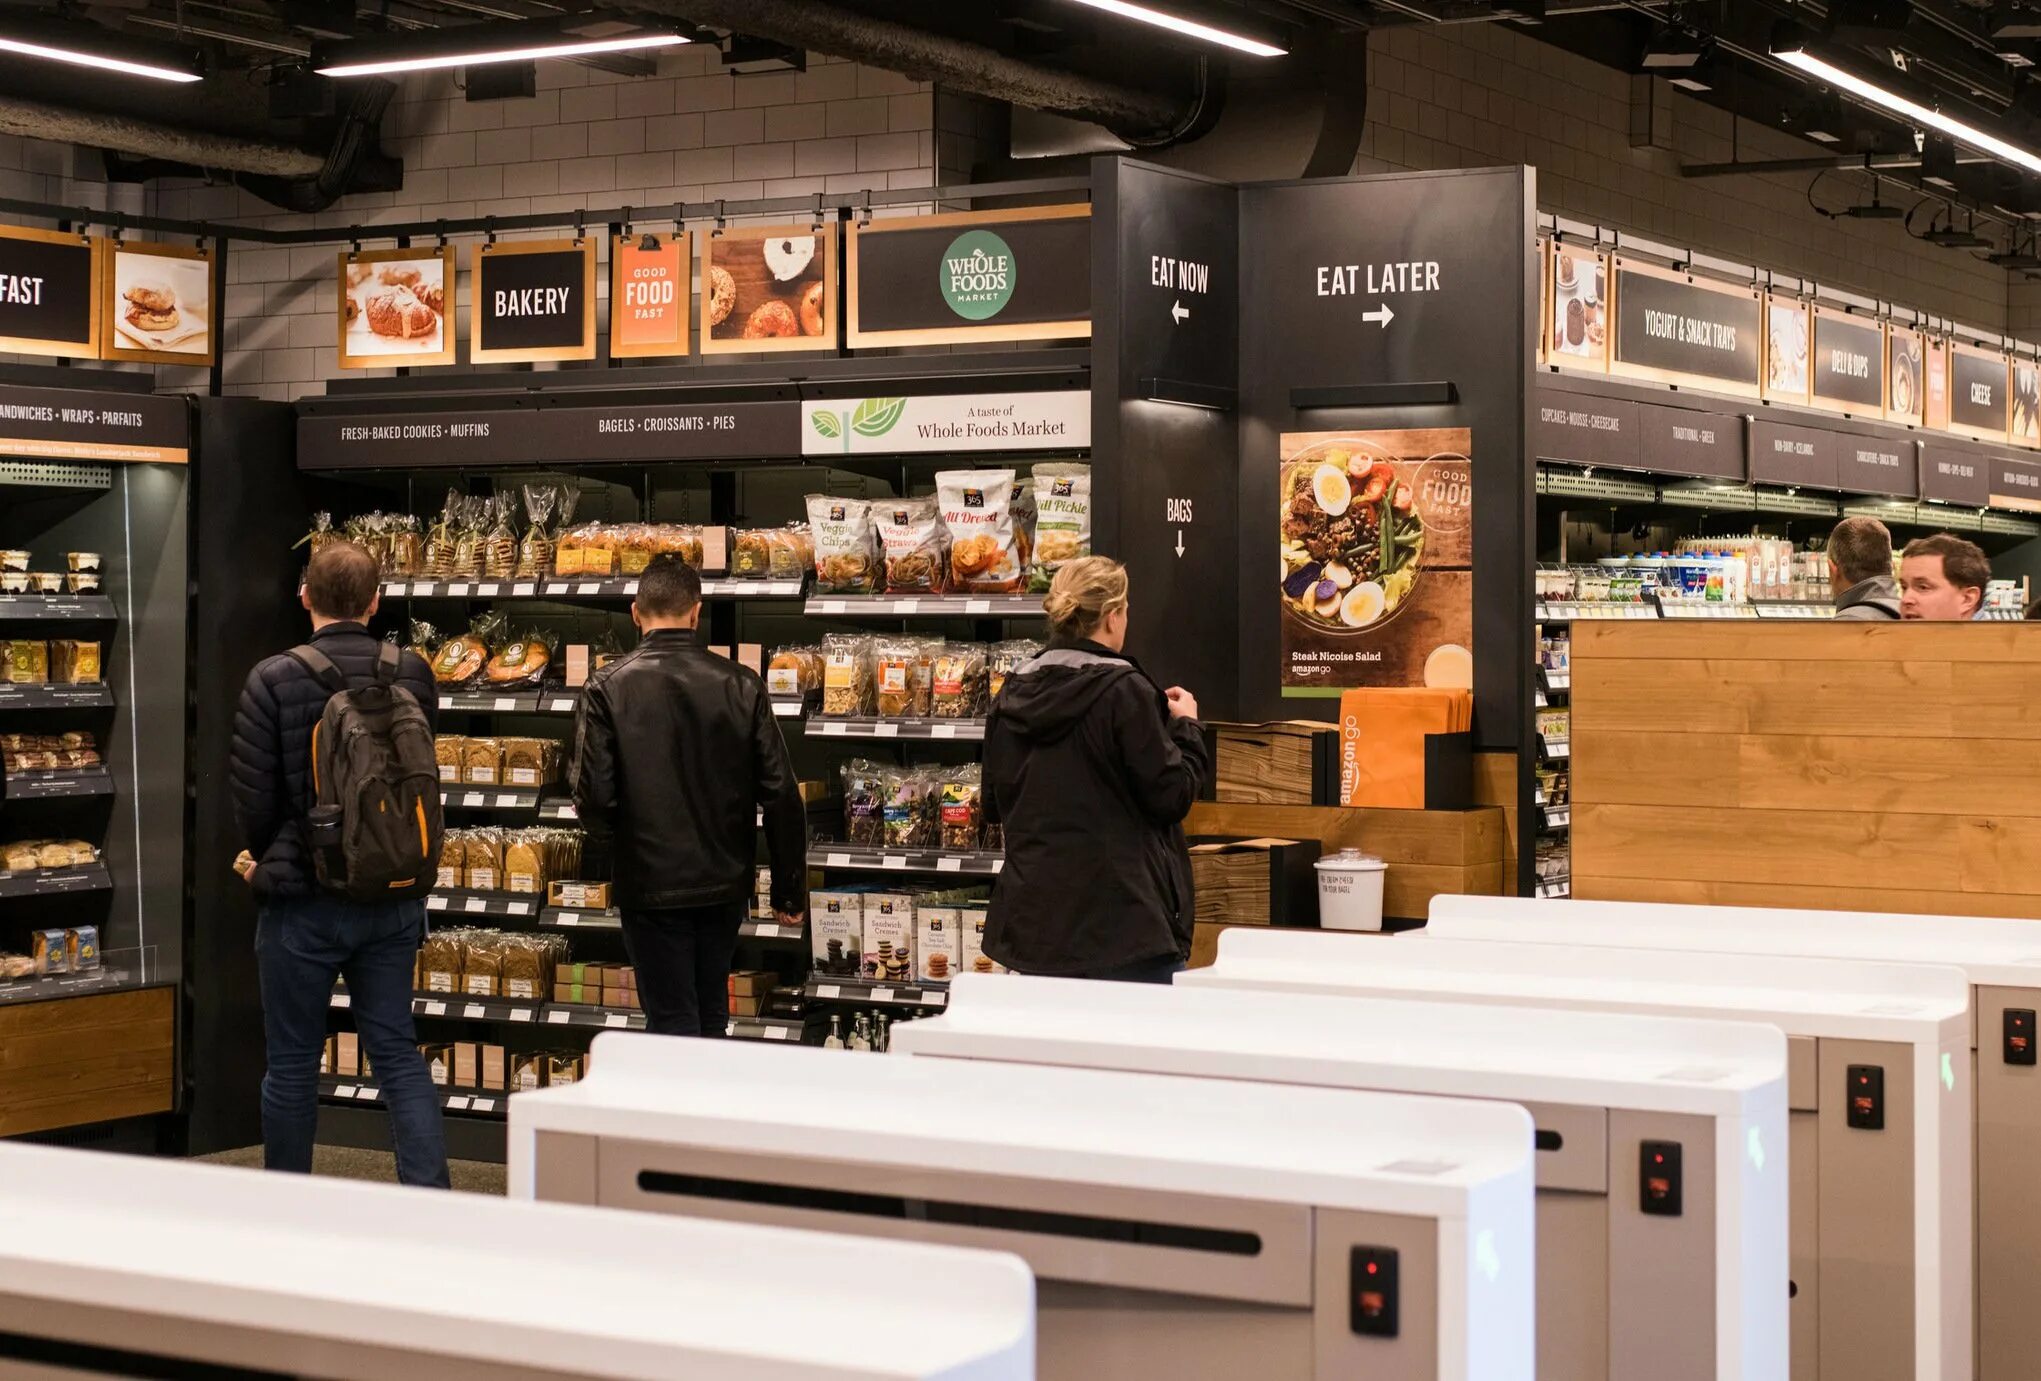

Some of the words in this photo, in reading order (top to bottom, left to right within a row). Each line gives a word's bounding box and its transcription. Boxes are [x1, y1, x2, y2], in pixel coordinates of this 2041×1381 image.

[633, 267, 667, 278] GOOD
[947, 253, 1009, 275] WHOLE
[951, 272, 1007, 293] FOODS
[1151, 255, 1176, 288] EAT
[1178, 260, 1209, 294] NOW
[1317, 265, 1359, 297] EAT
[1366, 261, 1440, 294] LATER
[494, 287, 570, 318] BAKERY
[625, 280, 674, 306] FOOD
[957, 292, 999, 303] MARKET
[634, 307, 665, 319] FAST
[1644, 308, 1678, 341] YOGURT
[1678, 315, 1686, 342] &
[1685, 317, 1712, 348] SNACK
[1712, 322, 1737, 352] TRAYS
[1831, 349, 1847, 375] DELI
[1853, 353, 1869, 379] DIPS
[1970, 381, 1992, 407] CHEESE
[61, 408, 95, 424] WRAPS
[101, 410, 143, 427] PARFAITS
[967, 407, 976, 417] A
[977, 407, 1002, 417] taste
[1002, 404, 1015, 417] of
[1541, 407, 1567, 425] CUPCAKES
[1591, 414, 1620, 432] CHEESECAKE
[341, 425, 401, 441] FRESH-BAKED
[403, 424, 442, 439] COOKIES
[450, 423, 490, 437] MUFFINS
[598, 418, 635, 433] BAGELS
[643, 416, 704, 432] CROISSANTS
[713, 415, 736, 430] PIES
[917, 422, 963, 439] Whole
[966, 420, 1009, 437] Foods
[1012, 419, 1066, 436] Market
[1433, 469, 1468, 482] GOOD
[967, 495, 982, 505] 365
[1422, 480, 1472, 507] FOOD
[1054, 499, 1089, 515] Pickle
[1167, 498, 1193, 523] BAGS
[961, 511, 999, 524] Dreed
[820, 522, 853, 536] Veggie
[822, 536, 851, 548] Chips
[1291, 651, 1319, 661] Steak
[1320, 651, 1354, 661] Nicoise
[1355, 651, 1382, 661] Salad
[1291, 665, 1320, 675] amazon
[1320, 665, 1332, 675] go
[1345, 715, 1361, 740] go
[1340, 741, 1358, 805] amazon
